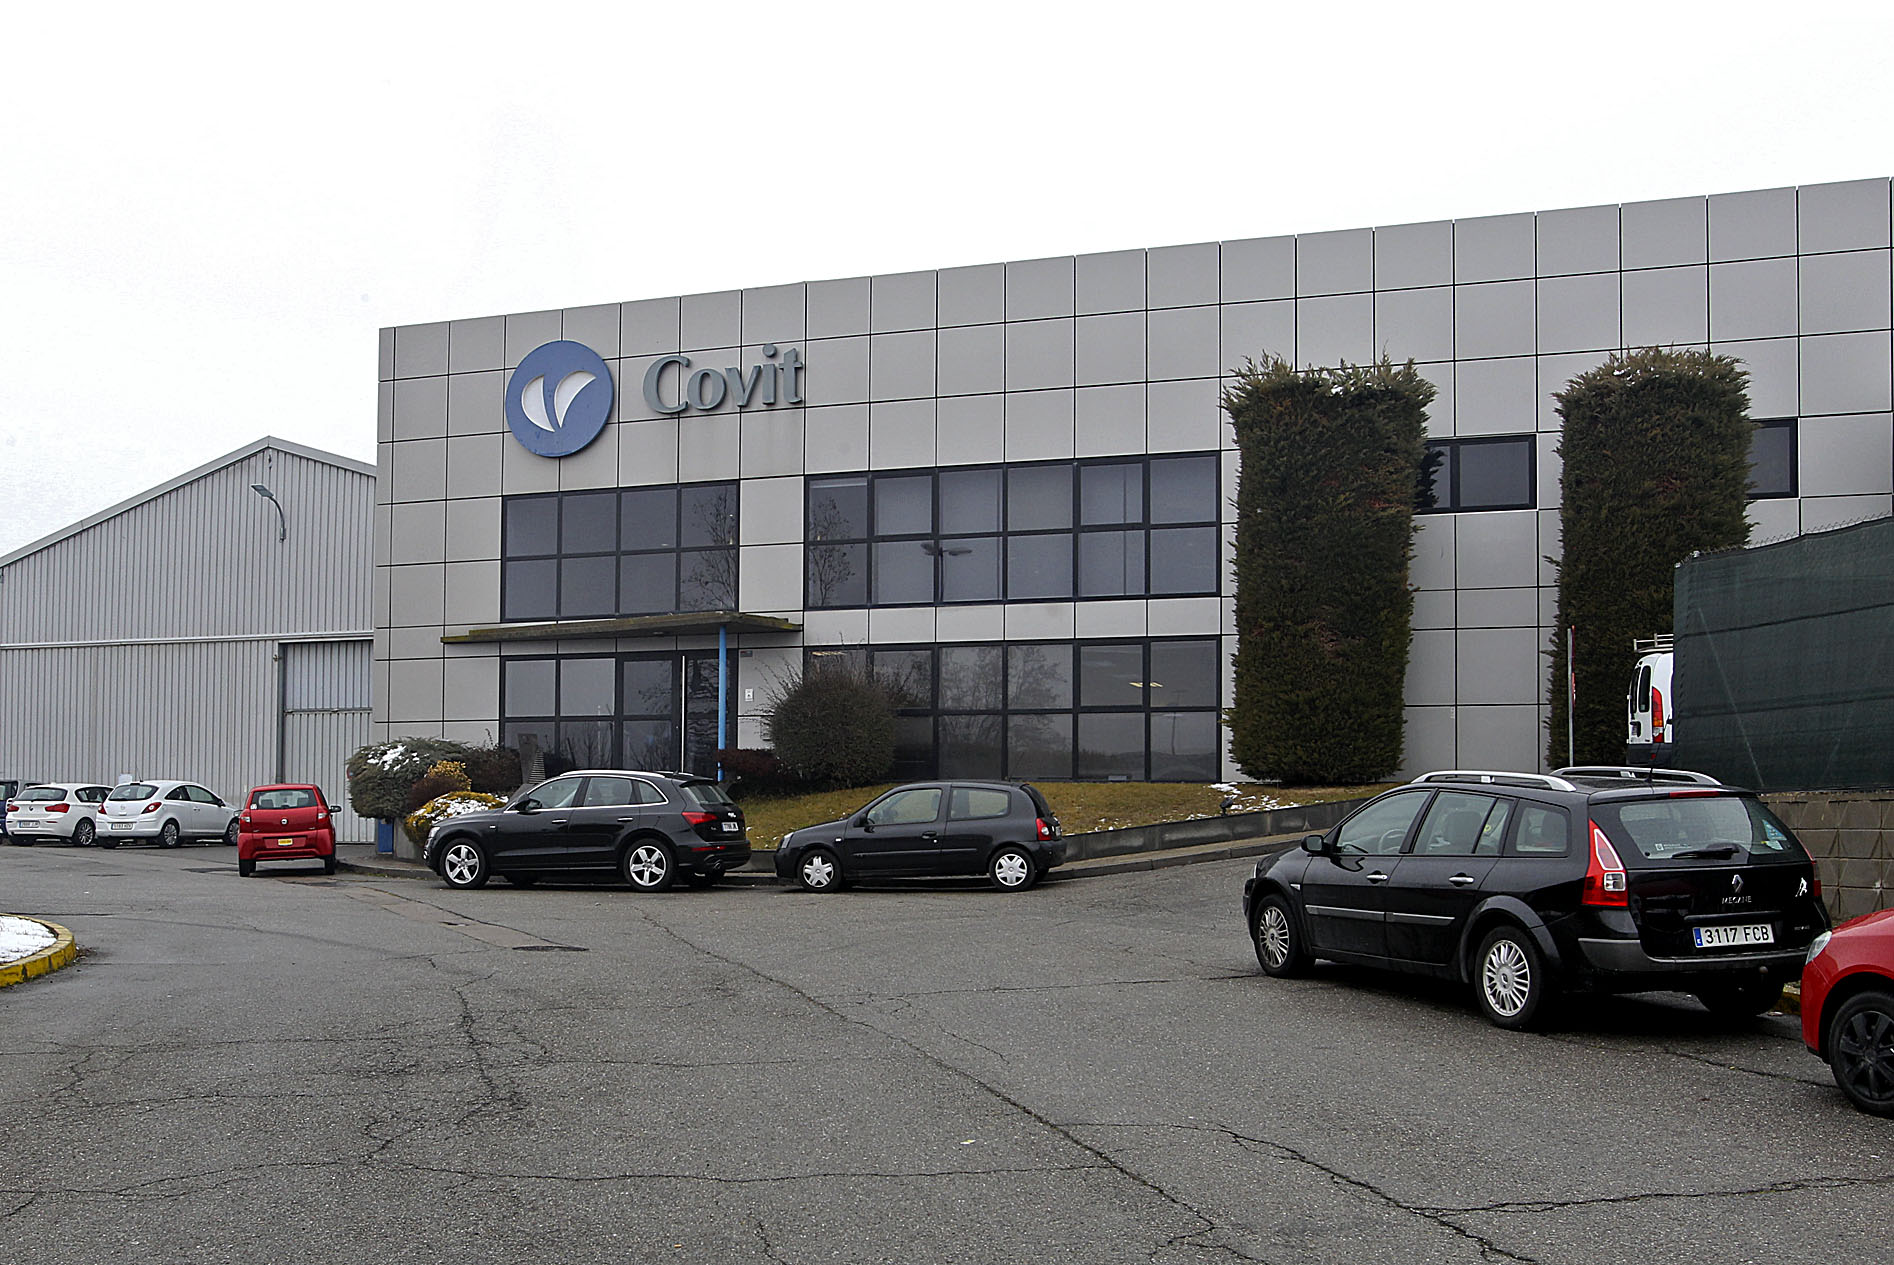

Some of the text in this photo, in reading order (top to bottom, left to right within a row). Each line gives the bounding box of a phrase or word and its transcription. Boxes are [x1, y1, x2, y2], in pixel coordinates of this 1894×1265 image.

[643, 344, 803, 414] Covit
[1704, 926, 1770, 944] 3117 FCB
